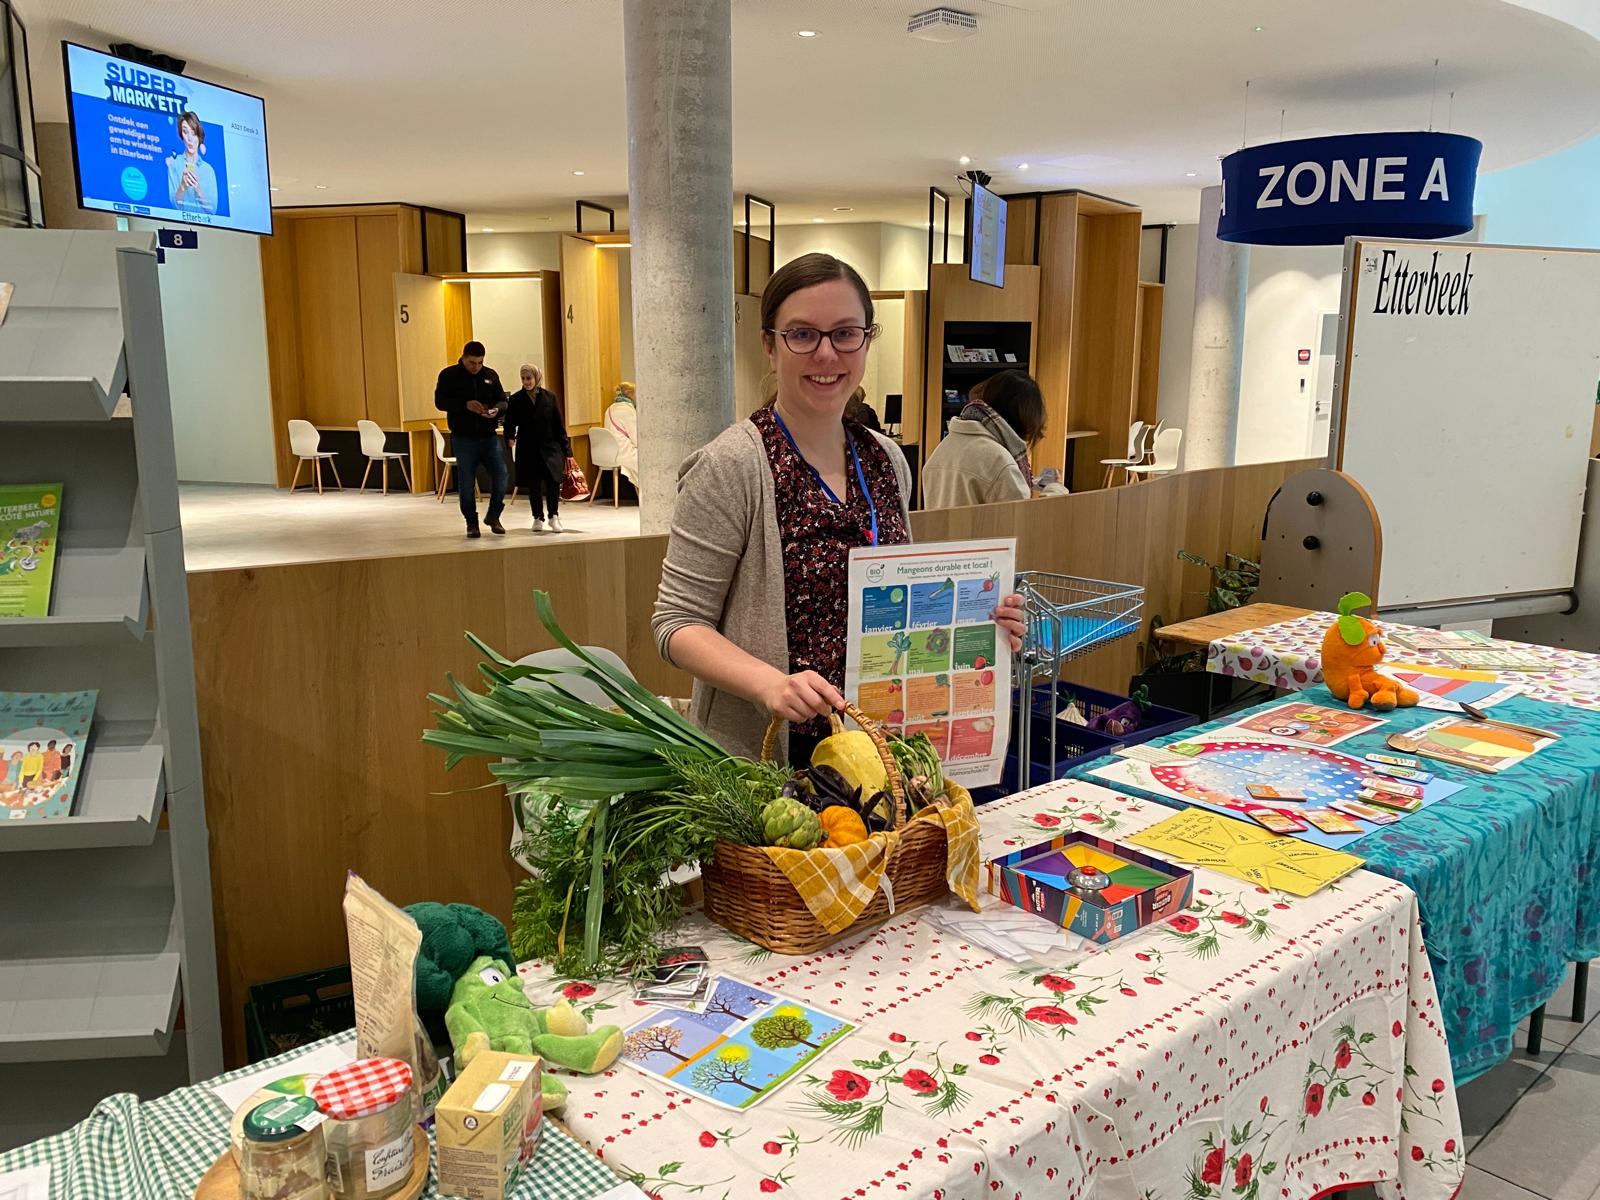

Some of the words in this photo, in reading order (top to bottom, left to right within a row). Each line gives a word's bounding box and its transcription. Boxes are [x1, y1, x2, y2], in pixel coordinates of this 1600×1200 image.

[106, 62, 176, 95] SUPER
[111, 84, 182, 115] MARK'ETT
[1256, 156, 1408, 210] ZONE
[1419, 157, 1449, 201] A
[173, 234, 183, 246] 8
[1373, 249, 1474, 316] Etterbeek
[400, 304, 410, 324] 5
[566, 303, 574, 324] 4
[869, 568, 881, 576] BIO
[896, 565, 933, 576] Mangeons
[934, 563, 961, 573] durable
[963, 562, 971, 570] et
[972, 560, 989, 569] local
